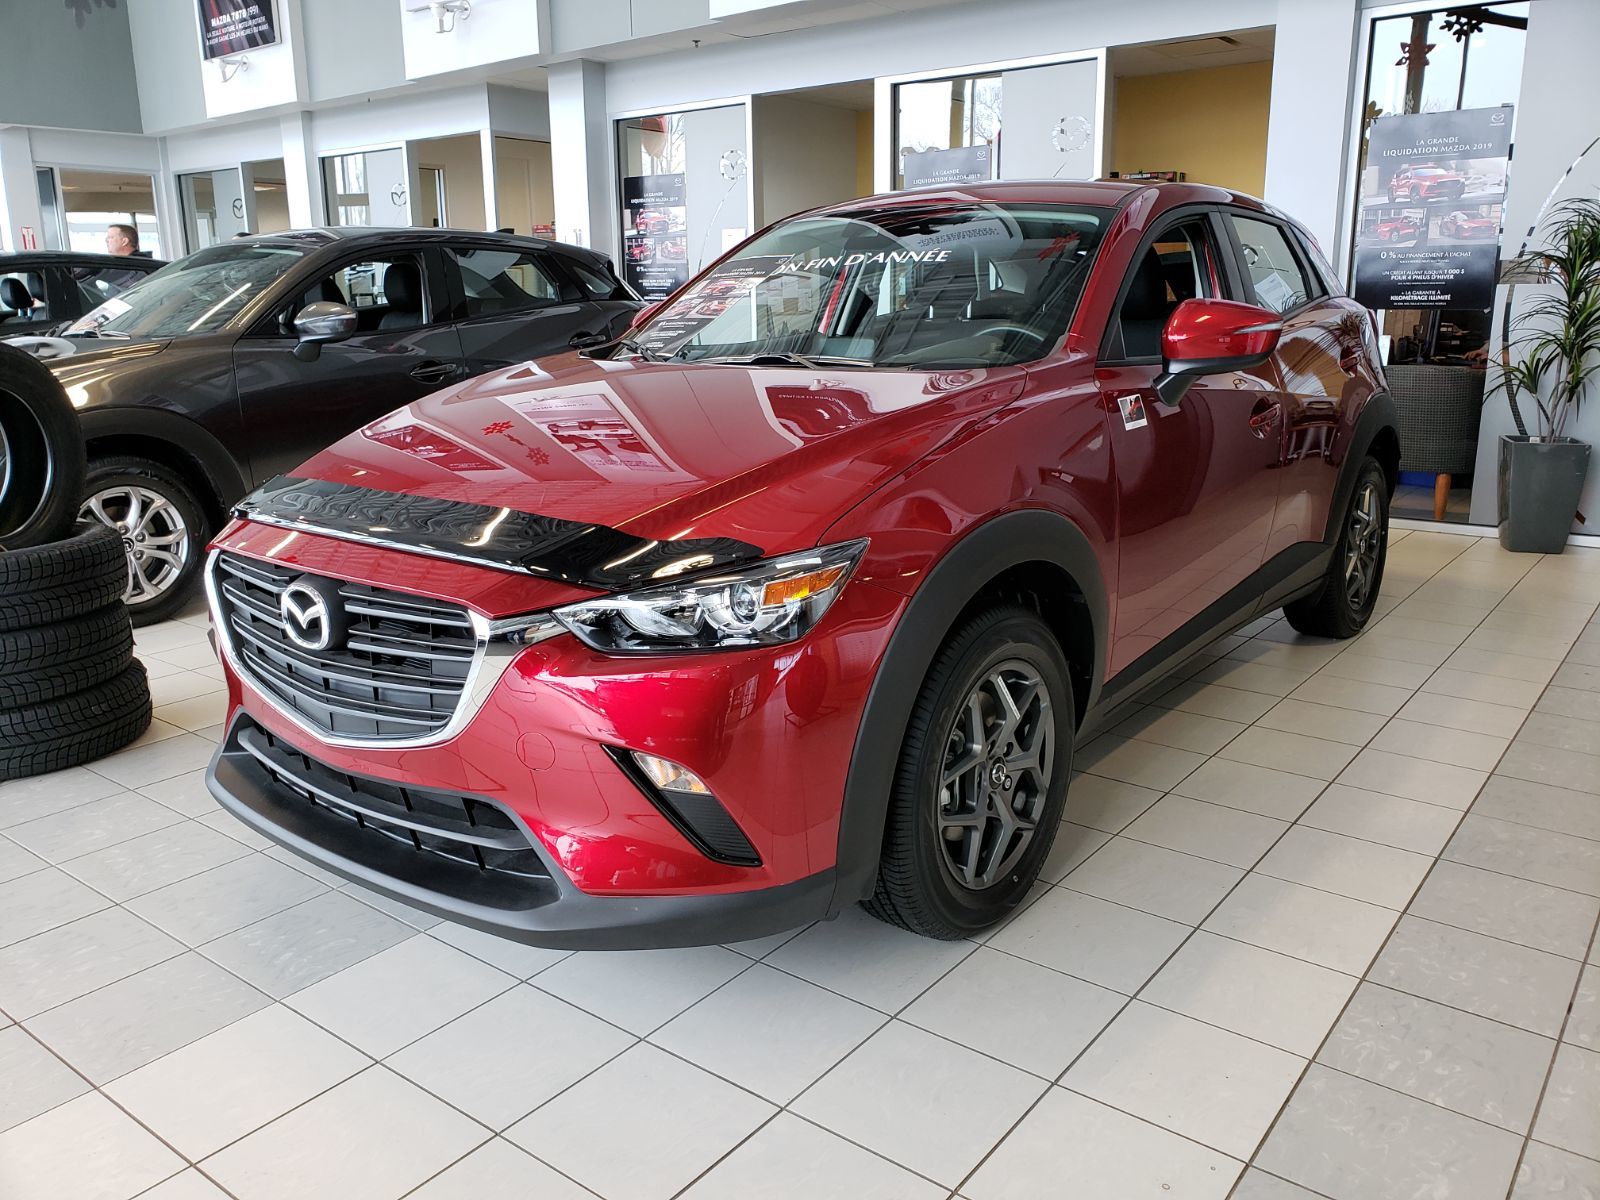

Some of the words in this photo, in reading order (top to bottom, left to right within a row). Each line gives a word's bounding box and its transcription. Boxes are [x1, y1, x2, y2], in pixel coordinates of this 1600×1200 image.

[210, 14, 231, 27] MAZDA
[1383, 146, 1438, 157] LIQUIDATION
[913, 176, 948, 185] LIQUIDATION
[804, 256, 843, 270] FIN
[844, 248, 952, 266] D'ANNÉE
